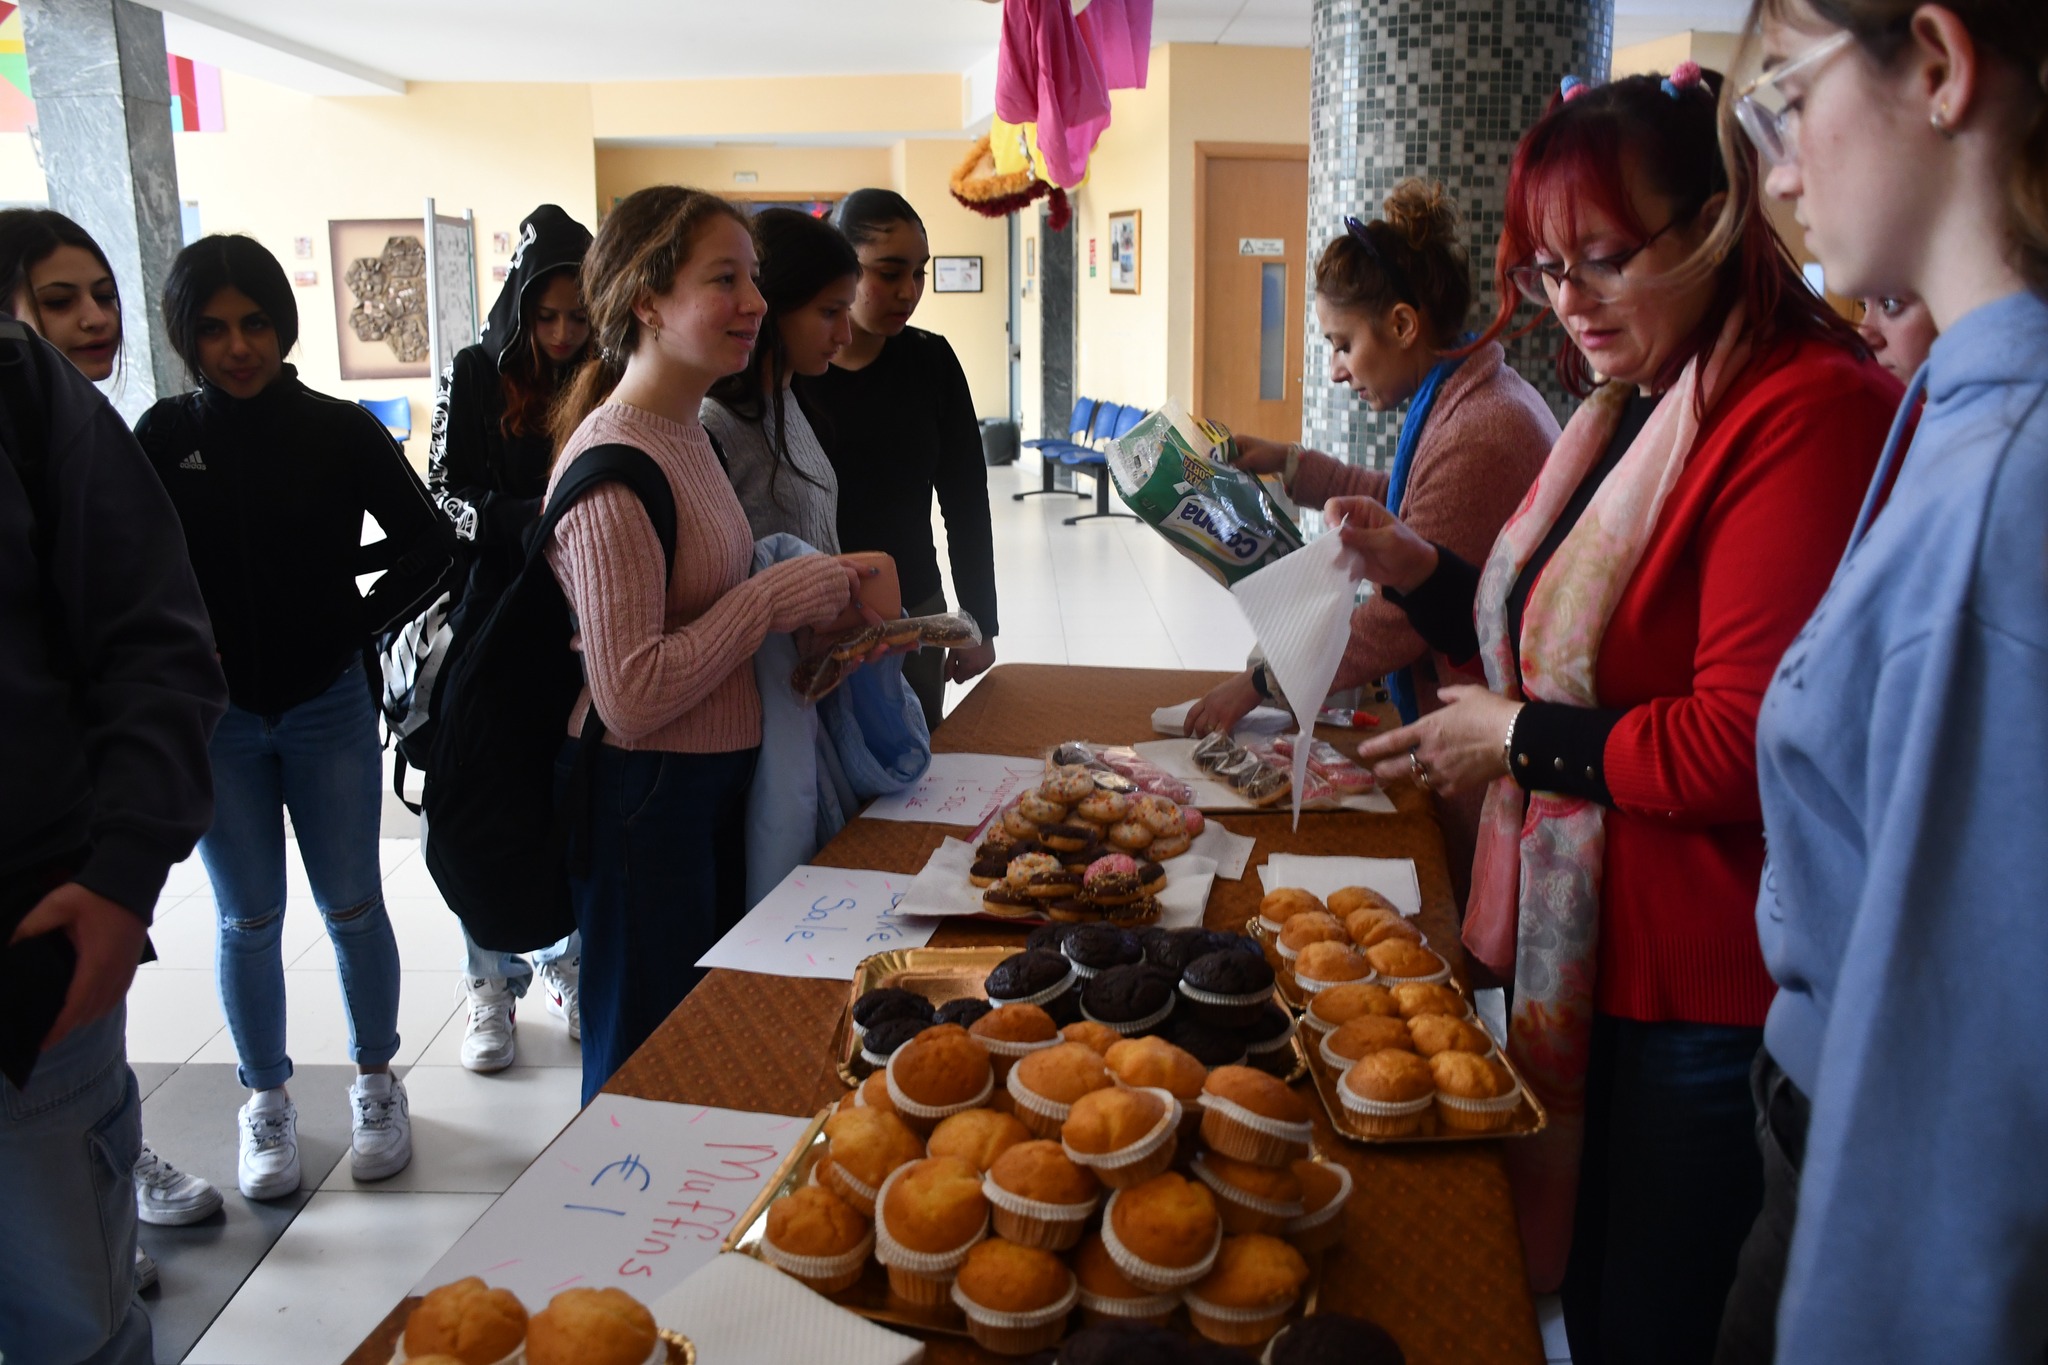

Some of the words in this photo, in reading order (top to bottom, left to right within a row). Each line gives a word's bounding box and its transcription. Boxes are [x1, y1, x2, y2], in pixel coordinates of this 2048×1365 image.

[380, 590, 451, 716] NIKE
[785, 896, 856, 942] Sale
[618, 1143, 778, 1277] Muffins
